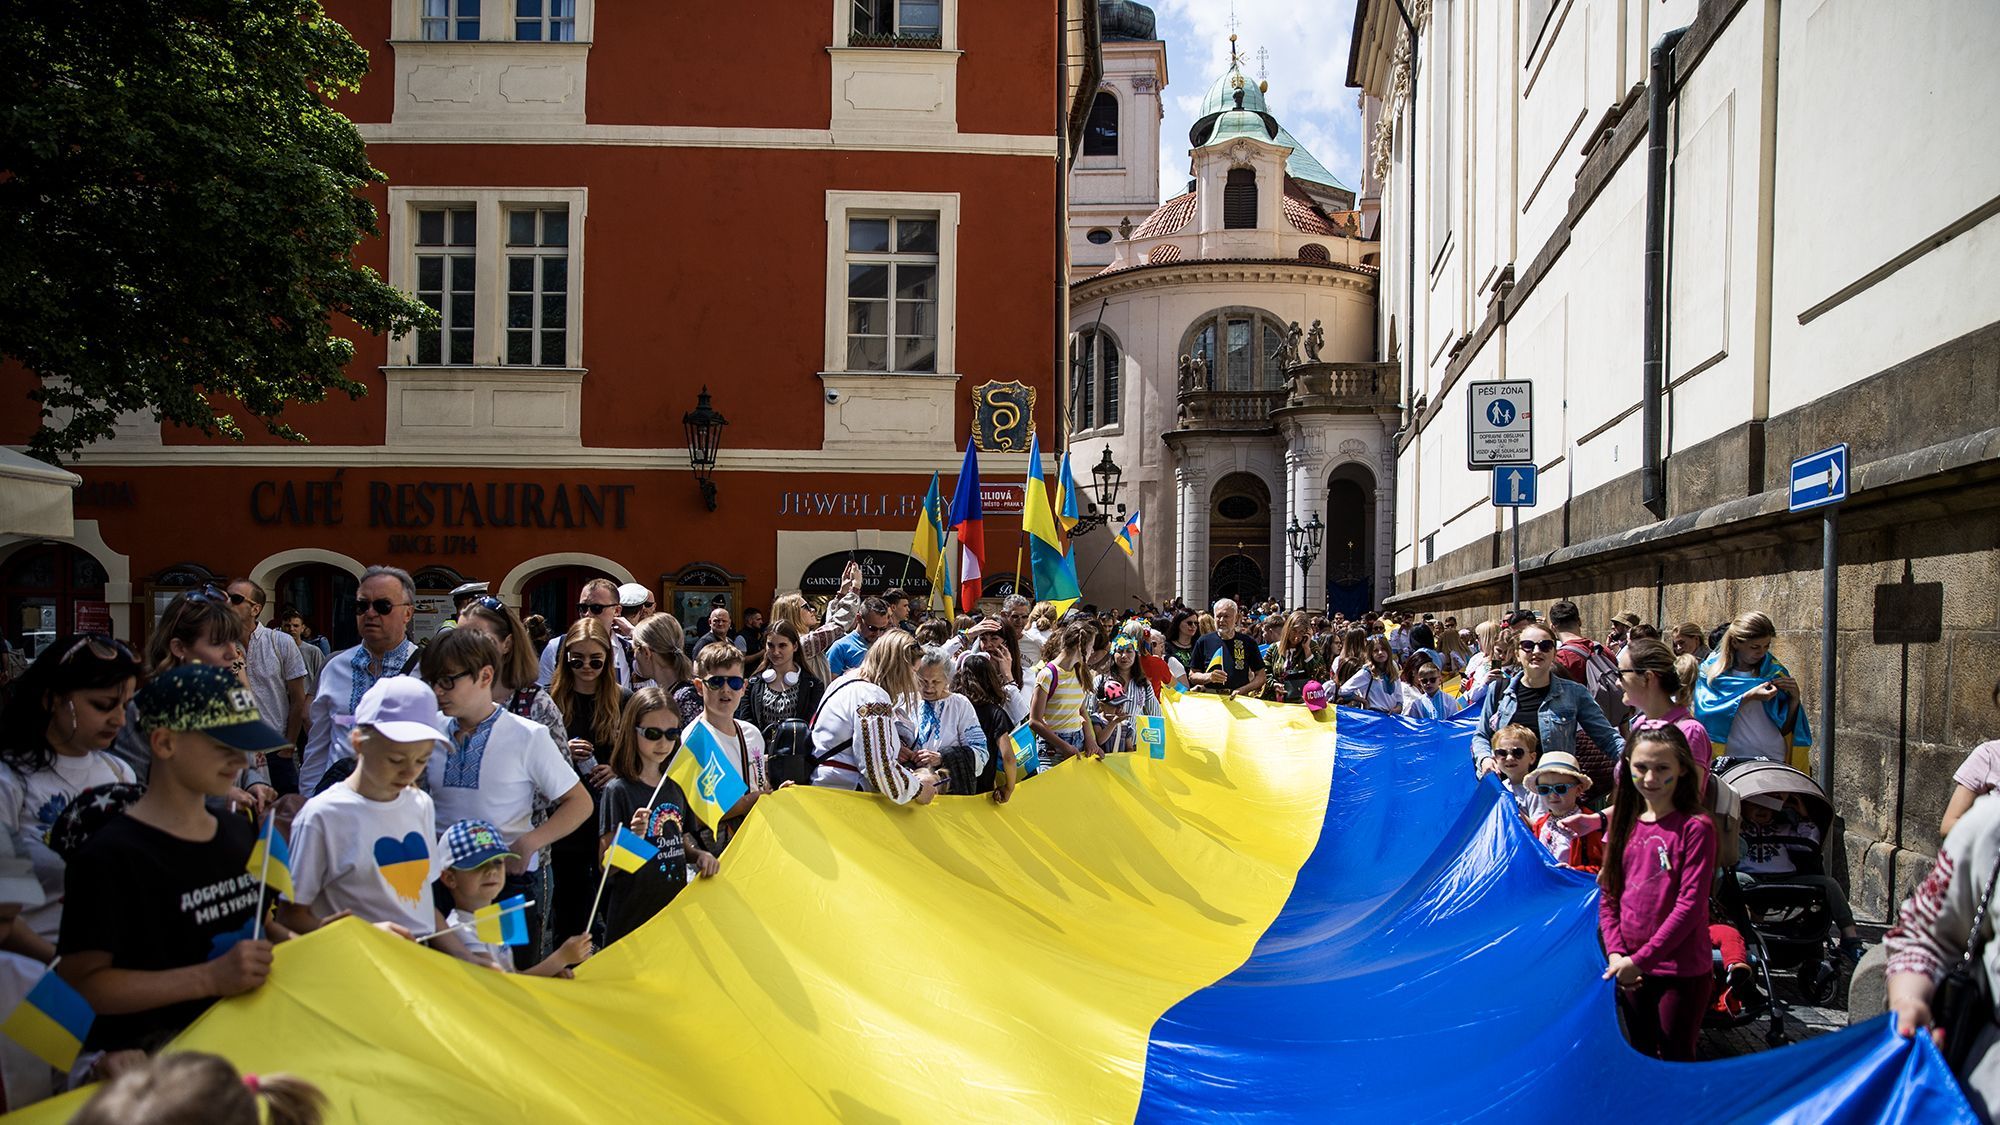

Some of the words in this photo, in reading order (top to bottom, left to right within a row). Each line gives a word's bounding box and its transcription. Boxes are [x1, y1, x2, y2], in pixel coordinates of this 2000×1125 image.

[1501, 386, 1524, 395] ZÓNA
[250, 467, 344, 524] CAFÉ
[368, 480, 635, 529] RESTAURANT
[779, 492, 956, 516] JEWELLEY
[980, 490, 1012, 500] LILIOVÁ
[388, 535, 437, 555] SINCE
[441, 535, 477, 555] 1714
[861, 565, 886, 575] ENY
[861, 577, 881, 586] OLD
[181, 878, 236, 912] ДОБРОГО
[195, 905, 219, 924] МИ
[220, 901, 229, 915] З
[229, 888, 260, 912] УКРАЇ
